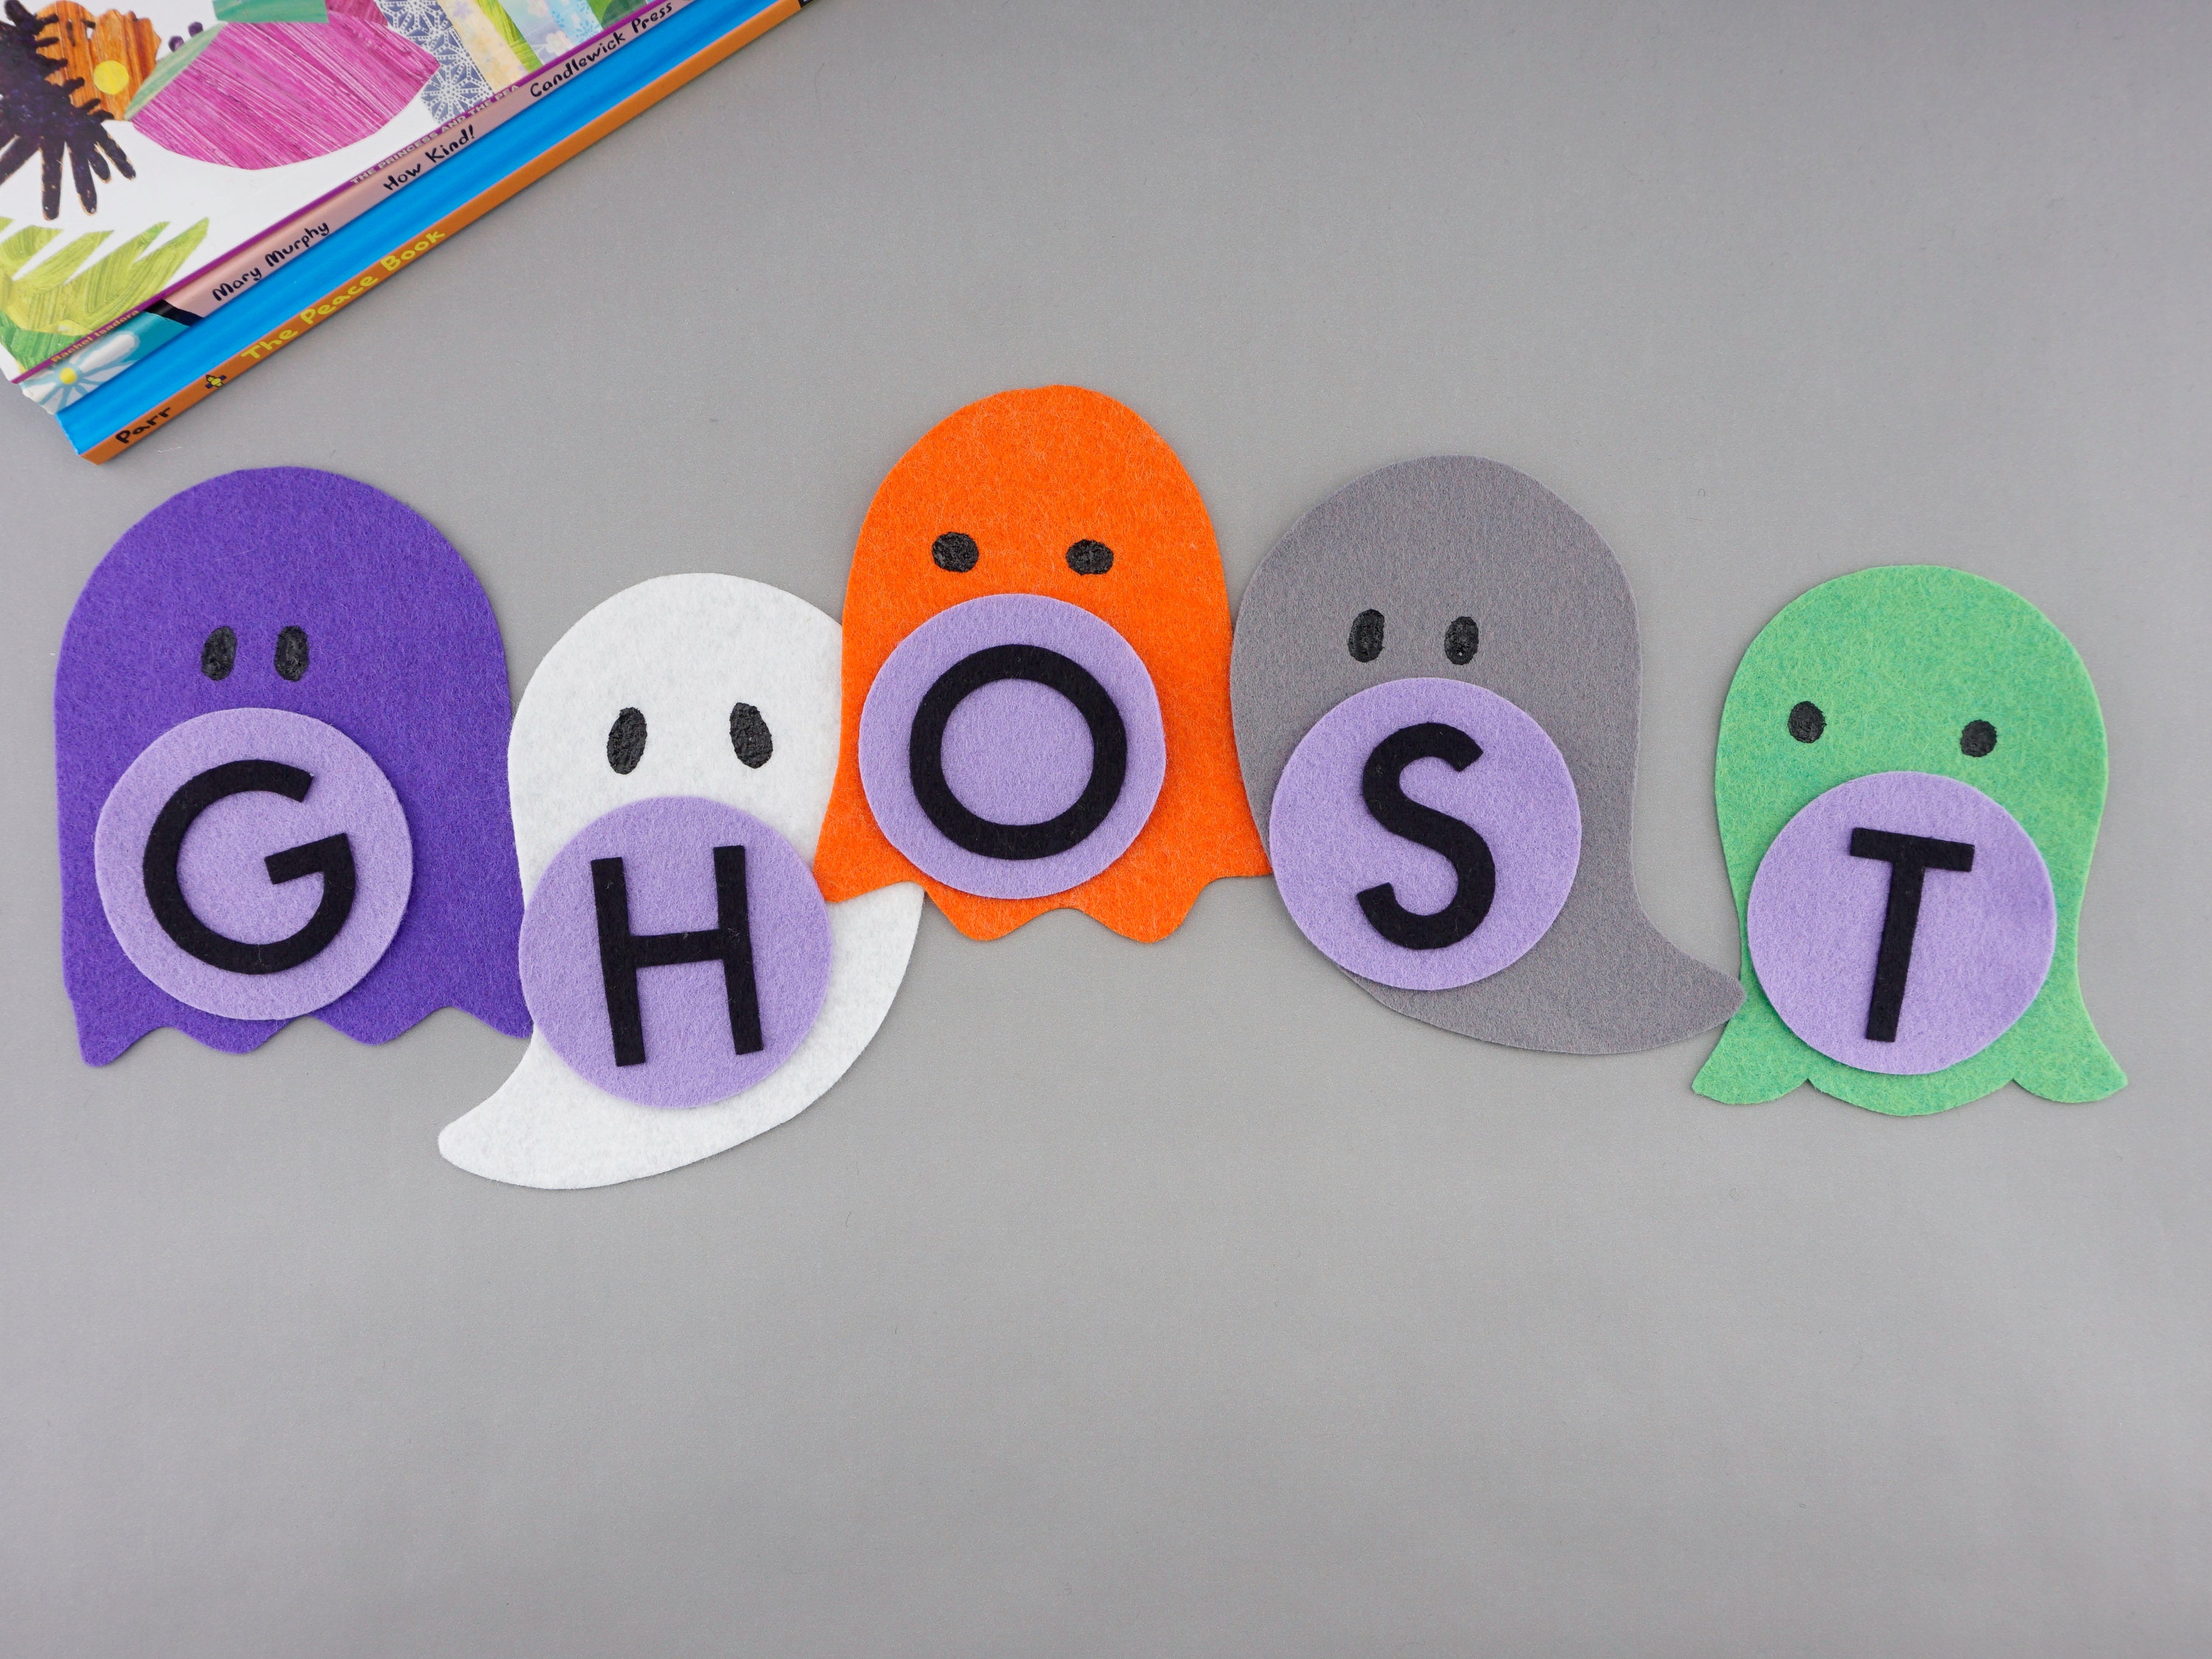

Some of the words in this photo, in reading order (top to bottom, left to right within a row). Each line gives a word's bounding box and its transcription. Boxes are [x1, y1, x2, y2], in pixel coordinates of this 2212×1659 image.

[529, 32, 626, 97] Candlewick
[631, 1, 672, 33] Press
[383, 163, 421, 191] How
[425, 124, 476, 163] Kind!
[212, 267, 262, 302] Mary
[264, 222, 330, 267] Murphy
[241, 329, 298, 360] The
[299, 274, 379, 325] Peace
[380, 230, 445, 272] Book
[51, 336, 94, 363] Rachel
[95, 310, 140, 337] Isadora
[115, 407, 171, 444] Parr
